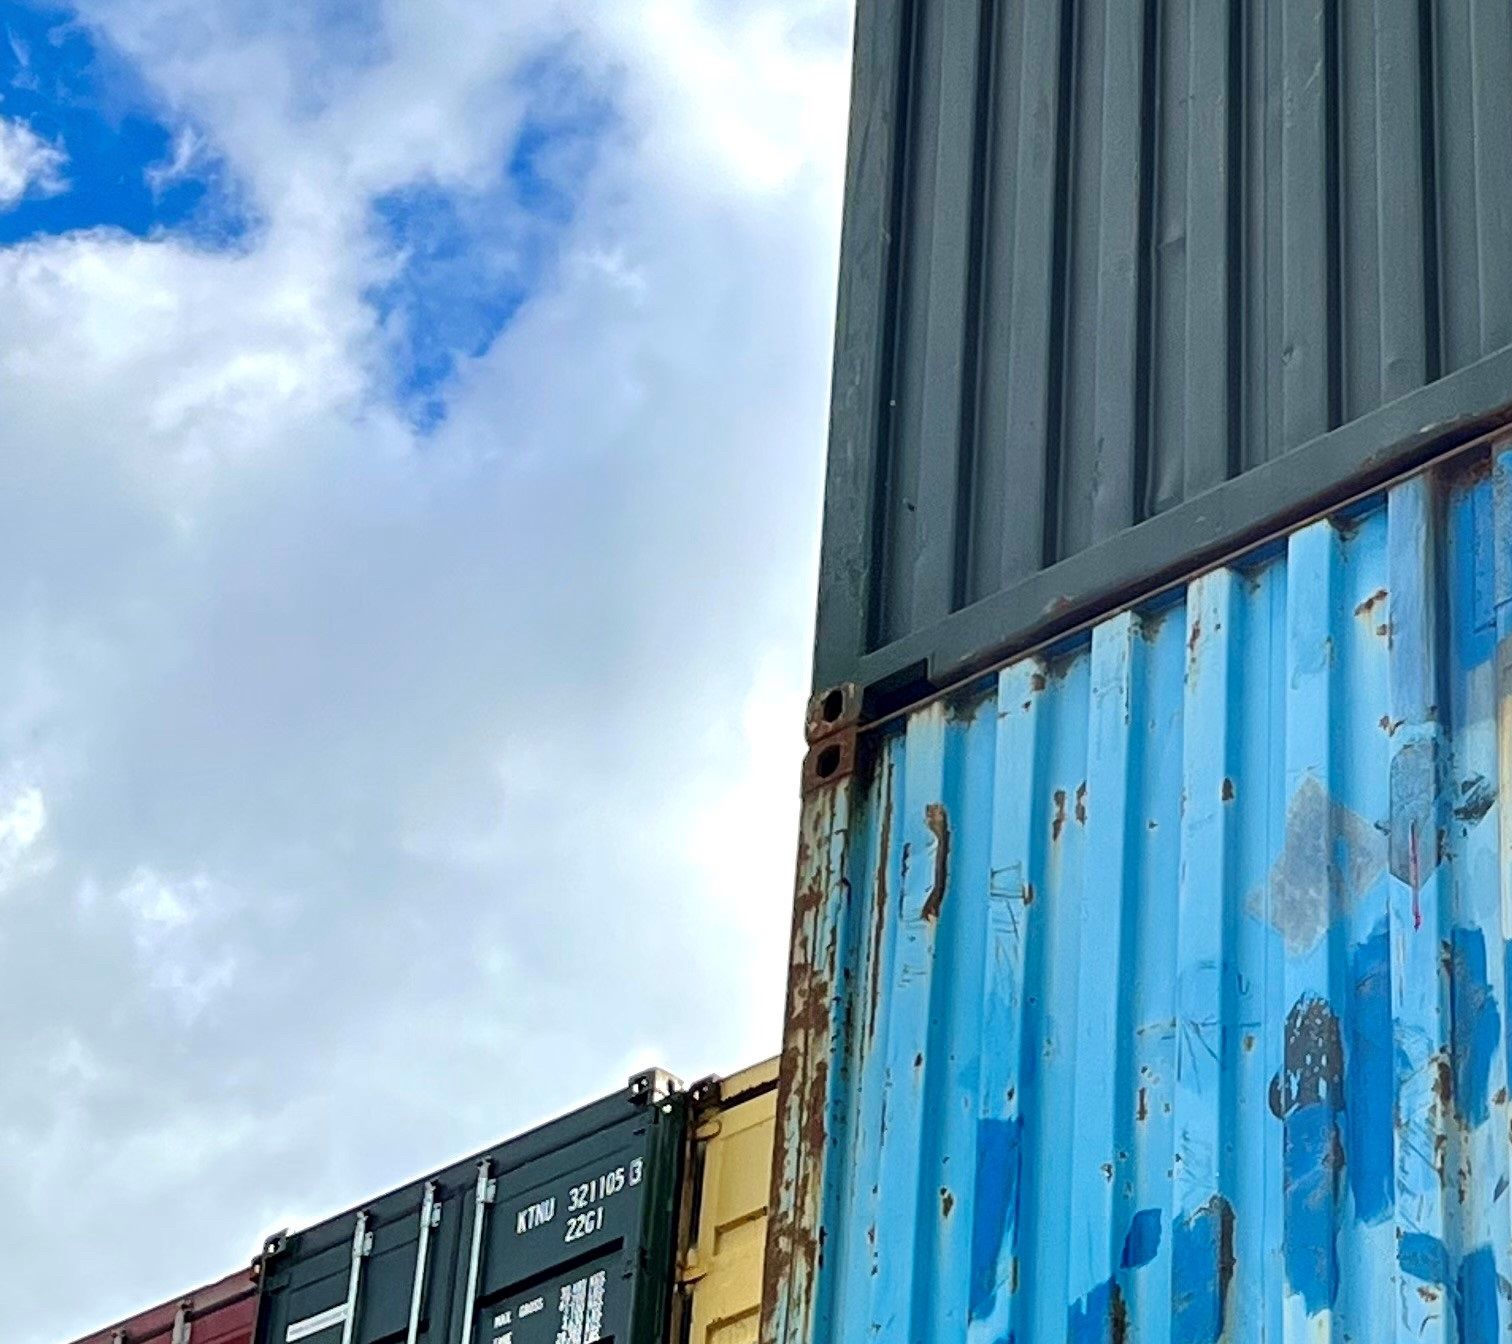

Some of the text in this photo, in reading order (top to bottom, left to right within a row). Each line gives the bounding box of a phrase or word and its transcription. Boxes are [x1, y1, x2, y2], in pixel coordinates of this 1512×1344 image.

[516, 1196, 556, 1235] KTNU
[567, 1166, 625, 1212] 321105
[564, 1206, 604, 1243] 22G1
